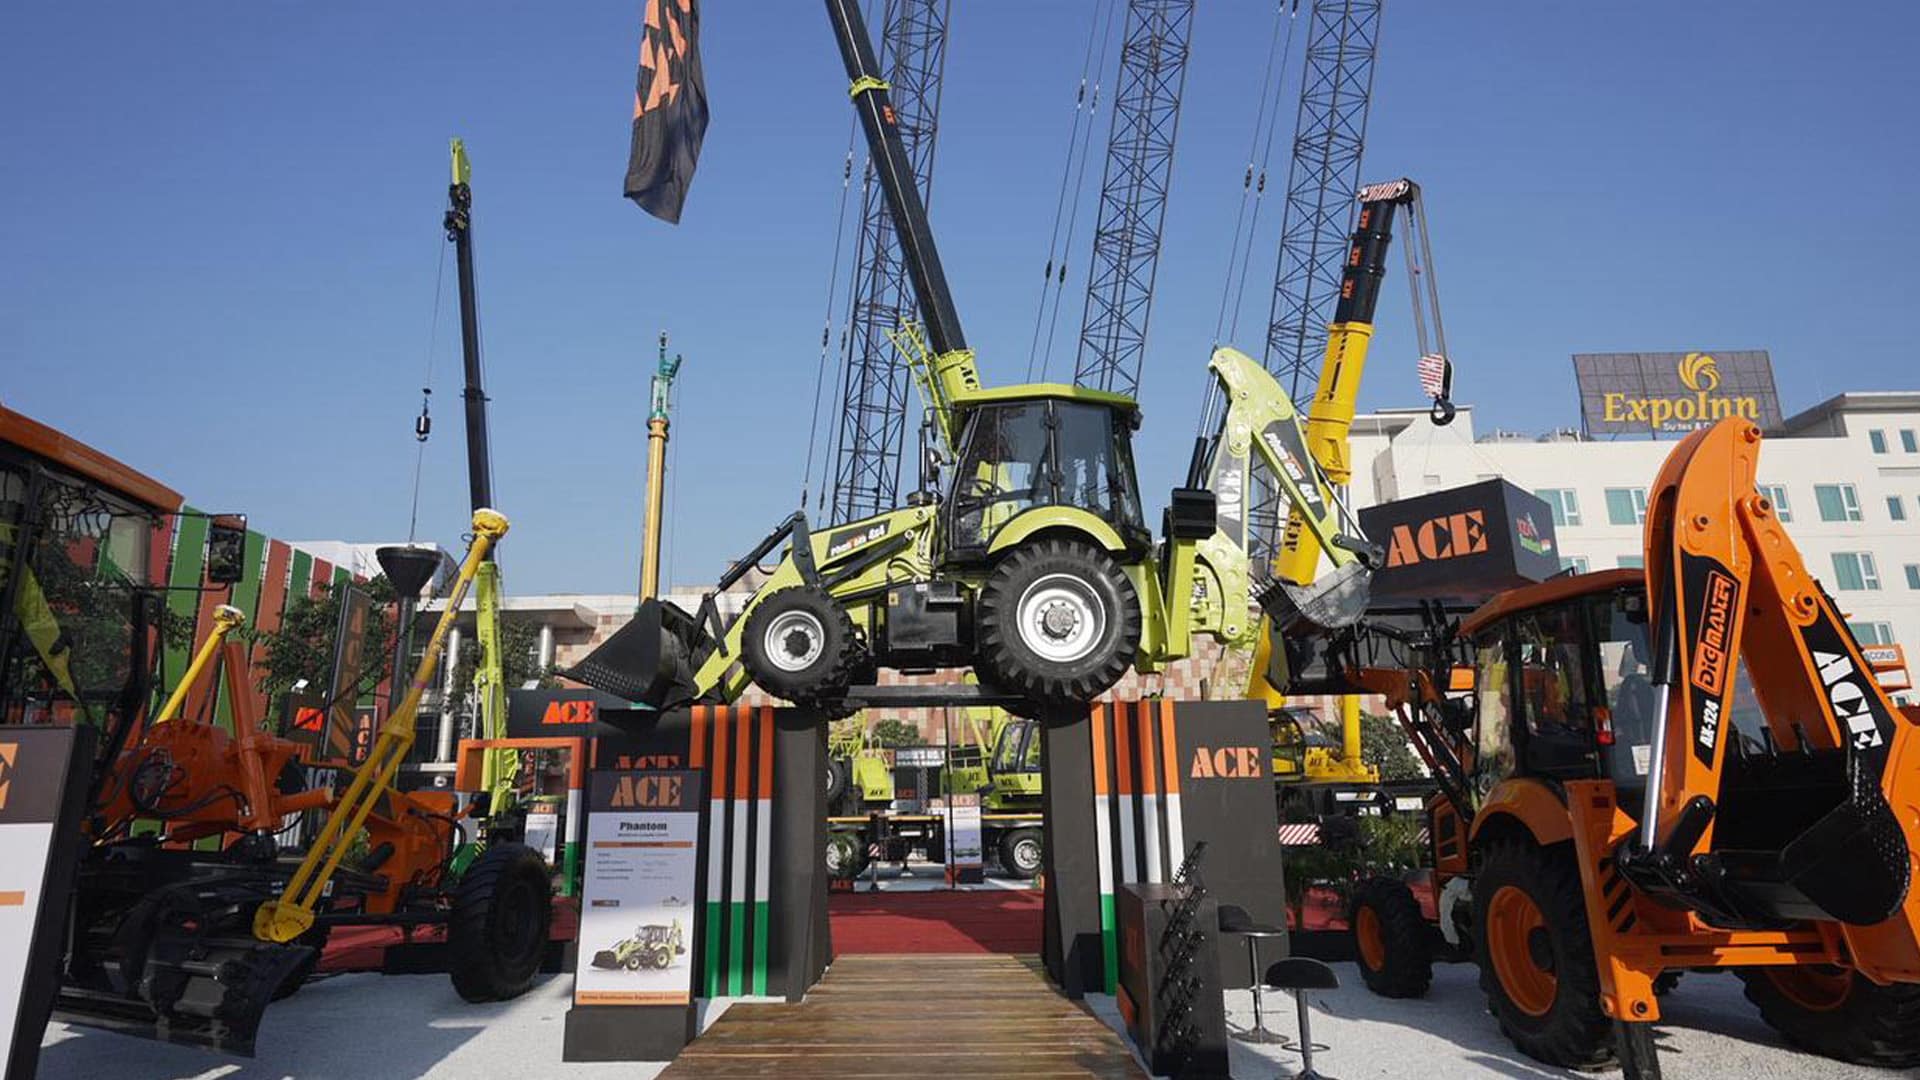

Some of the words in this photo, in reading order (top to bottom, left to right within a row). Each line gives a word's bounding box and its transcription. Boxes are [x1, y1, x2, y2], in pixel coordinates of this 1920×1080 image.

[1603, 391, 1759, 429] ExpoInn
[1387, 510, 1489, 568] ACE
[541, 701, 597, 725] ACE
[1813, 651, 1883, 750] ACE
[1191, 747, 1261, 778] ACE
[611, 776, 682, 807] ACE
